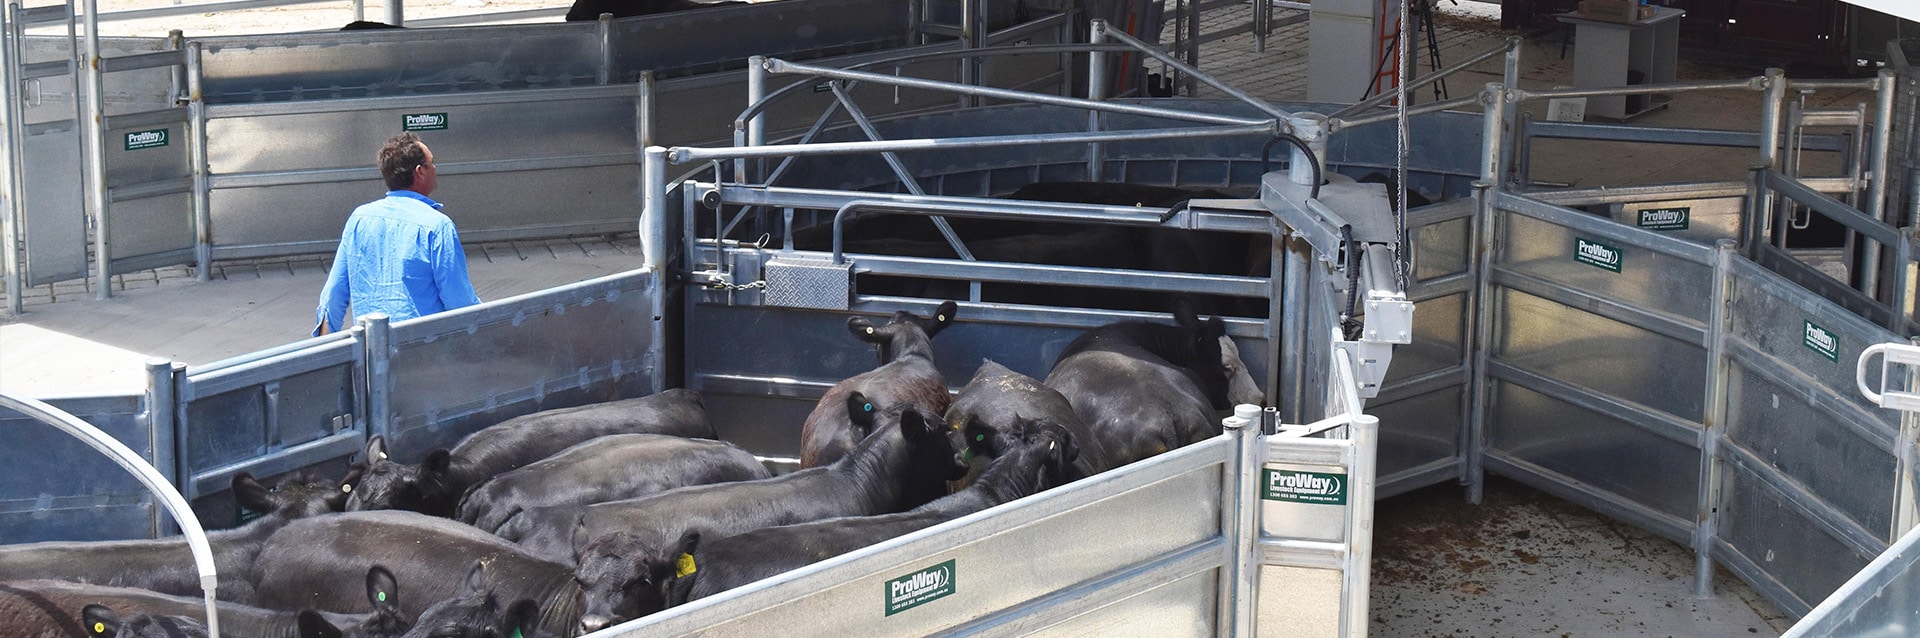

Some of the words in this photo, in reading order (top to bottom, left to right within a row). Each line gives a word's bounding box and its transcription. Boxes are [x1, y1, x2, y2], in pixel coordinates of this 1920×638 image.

[406, 114, 439, 125] ProWay
[128, 132, 160, 142] ProWay
[1642, 210, 1679, 223] ProWay
[1579, 240, 1613, 263] ProWay
[1806, 322, 1833, 350] ProWay
[1270, 471, 1331, 494] ProWay
[891, 570, 941, 597] ProWay
